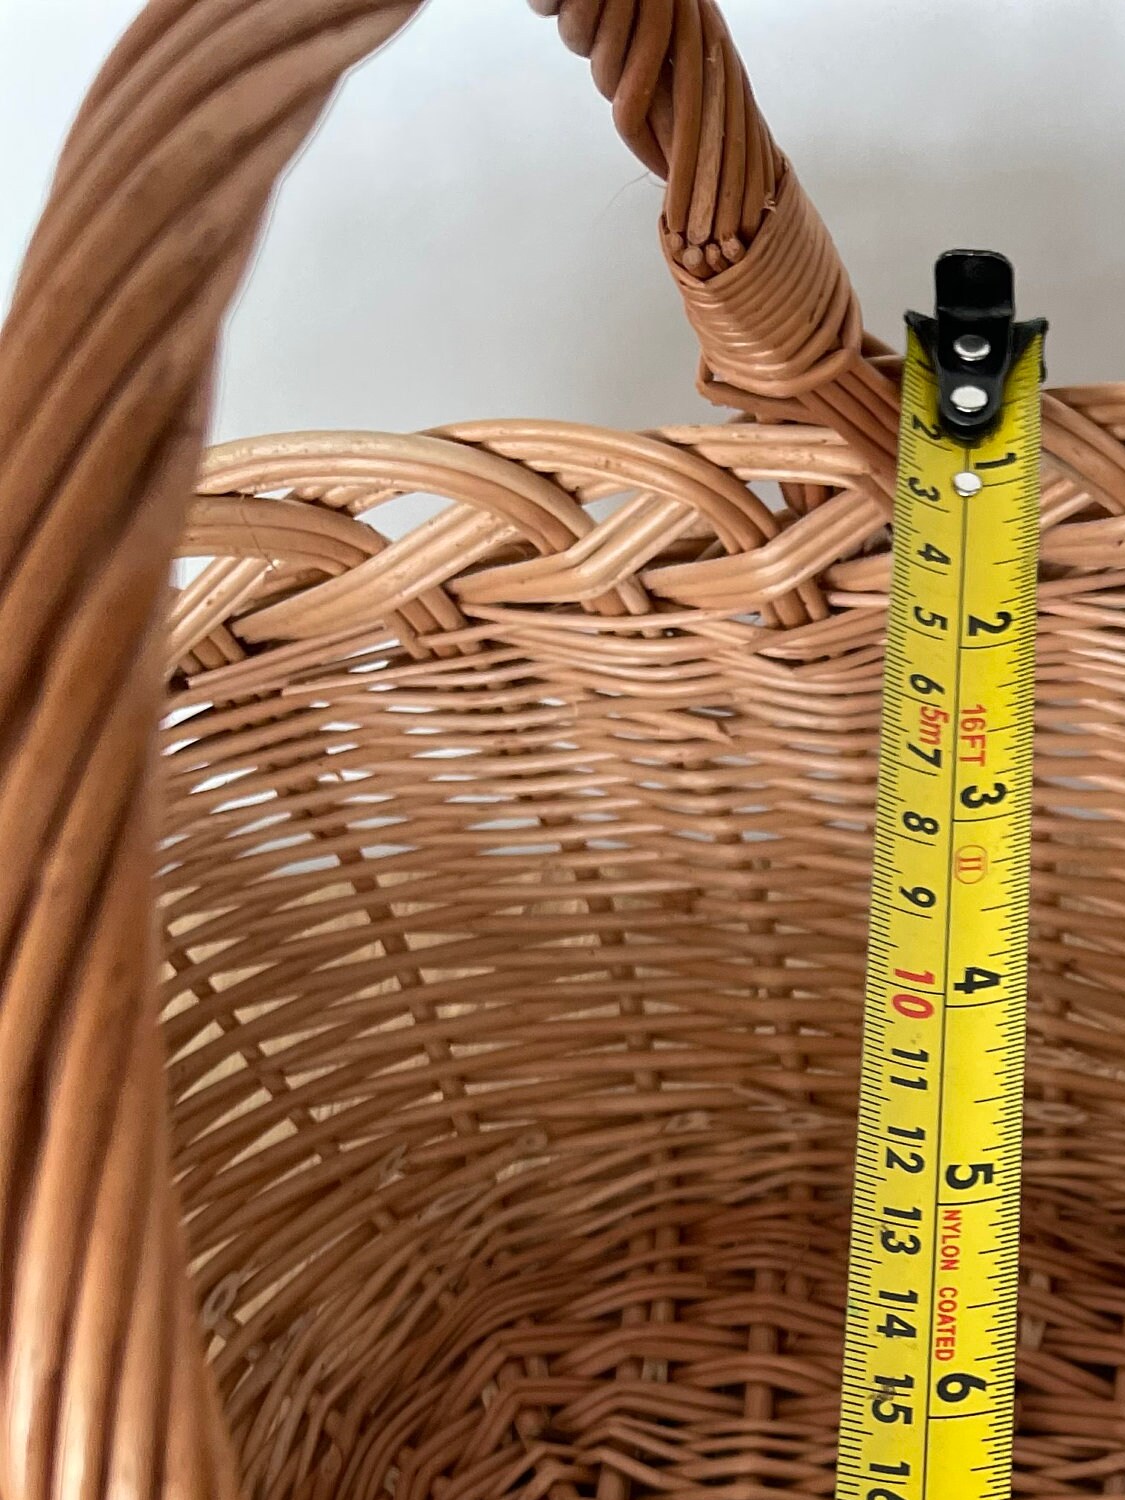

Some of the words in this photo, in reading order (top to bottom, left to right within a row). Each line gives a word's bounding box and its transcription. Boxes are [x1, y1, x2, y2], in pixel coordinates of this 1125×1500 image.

[911, 414, 942, 440] 2
[974, 452, 1017, 470] 1
[908, 477, 940, 502] 3
[917, 543, 951, 565] 4
[914, 606, 948, 631] 5
[968, 611, 1013, 637] 2
[910, 673, 945, 696] 6
[919, 705, 949, 745] 5m
[959, 704, 986, 767] 16FT
[906, 742, 943, 768] 7
[959, 782, 1007, 808] 3
[902, 811, 940, 835] 8
[899, 886, 937, 909] 9
[891, 967, 935, 1019] 10
[953, 966, 1000, 994] 4
[889, 1047, 930, 1091] 11
[885, 1125, 926, 1174] 12
[945, 1162, 994, 1190] 5
[880, 1206, 922, 1256] 13
[938, 1208, 962, 1271] NYLON
[876, 1289, 919, 1338] 14
[934, 1286, 958, 1362] COATED
[871, 1374, 915, 1425] 15
[936, 1372, 987, 1403] 6
